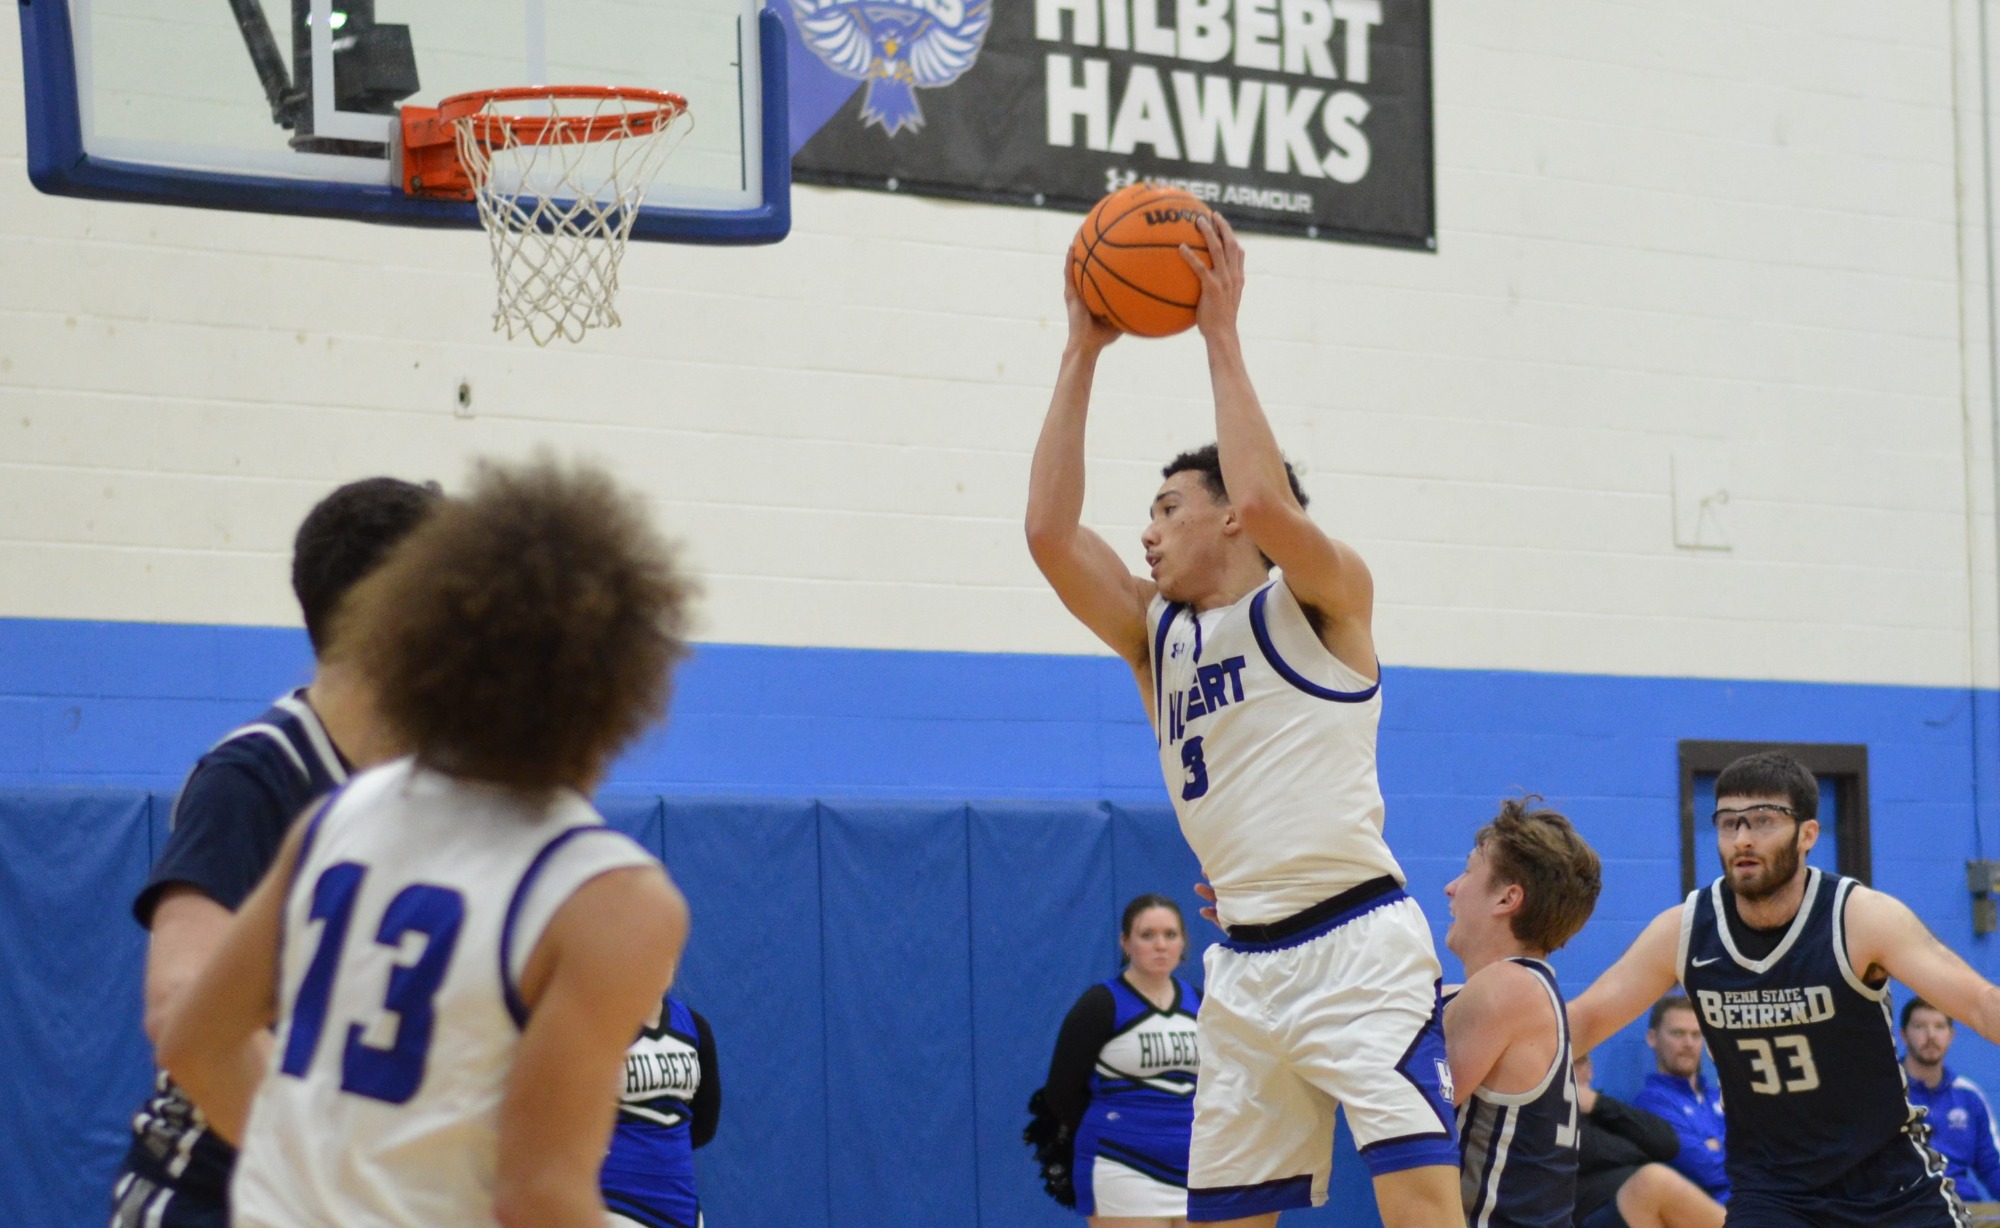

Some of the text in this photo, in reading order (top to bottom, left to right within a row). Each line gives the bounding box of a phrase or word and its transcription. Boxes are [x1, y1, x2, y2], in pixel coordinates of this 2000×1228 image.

[1046, 54, 1372, 184] HAWKS
[1222, 185, 1313, 214] ARMOUR
[1181, 735, 1209, 801] 3
[280, 861, 466, 1104] 13
[1697, 985, 1836, 1030] BEHREND
[1724, 987, 1802, 1003] PENN STATE
[1736, 1034, 1820, 1095] 33
